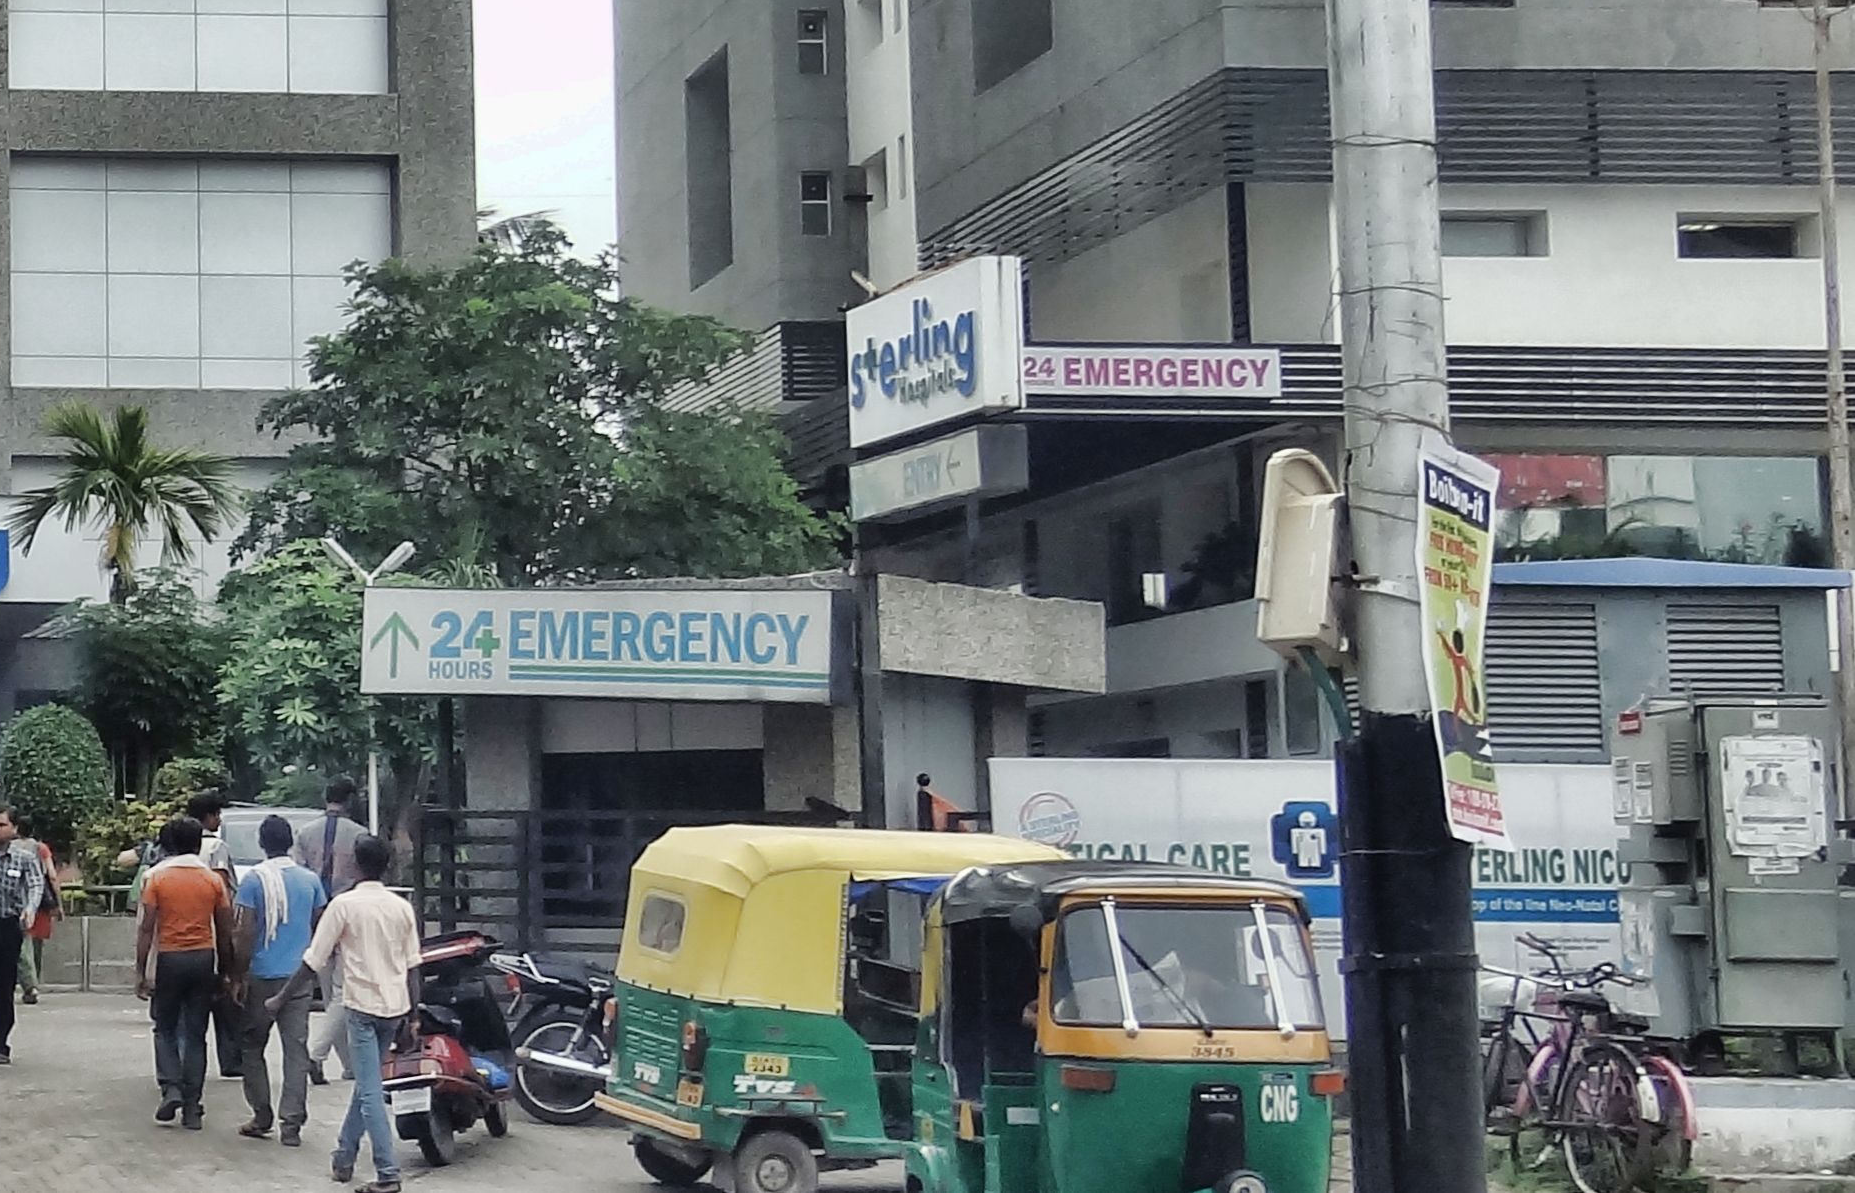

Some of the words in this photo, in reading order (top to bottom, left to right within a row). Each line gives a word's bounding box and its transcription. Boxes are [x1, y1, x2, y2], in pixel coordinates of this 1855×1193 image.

[851, 297, 977, 410] sterling
[1024, 357, 1055, 378] 24
[1064, 358, 1270, 387] EMERGENCY
[429, 610, 501, 659] 24
[509, 610, 810, 665] EMERGENCY
[428, 661, 493, 680] HOURS
[1478, 848, 1565, 883] ERLING
[734, 1074, 795, 1094] TVS
[1260, 1084, 1298, 1122] CNG
